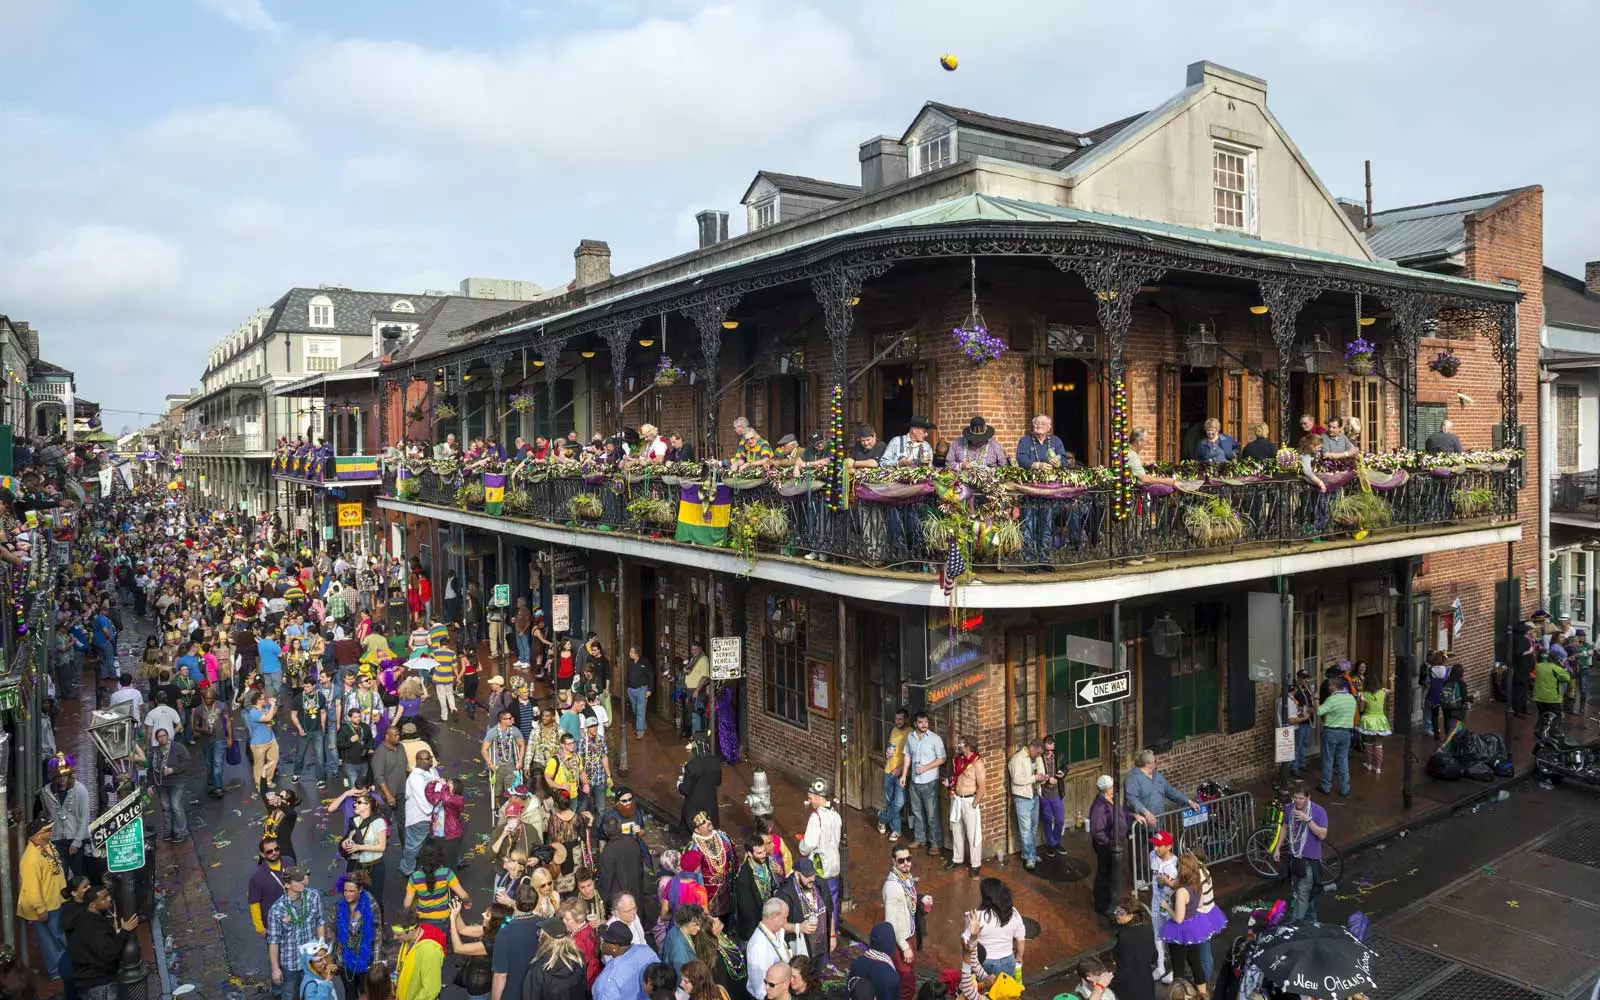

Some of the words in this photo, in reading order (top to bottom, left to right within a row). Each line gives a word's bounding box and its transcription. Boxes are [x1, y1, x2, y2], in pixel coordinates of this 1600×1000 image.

[1093, 683, 1110, 697] ONE
[1110, 679, 1125, 692] WAY
[94, 825, 112, 846] St.
